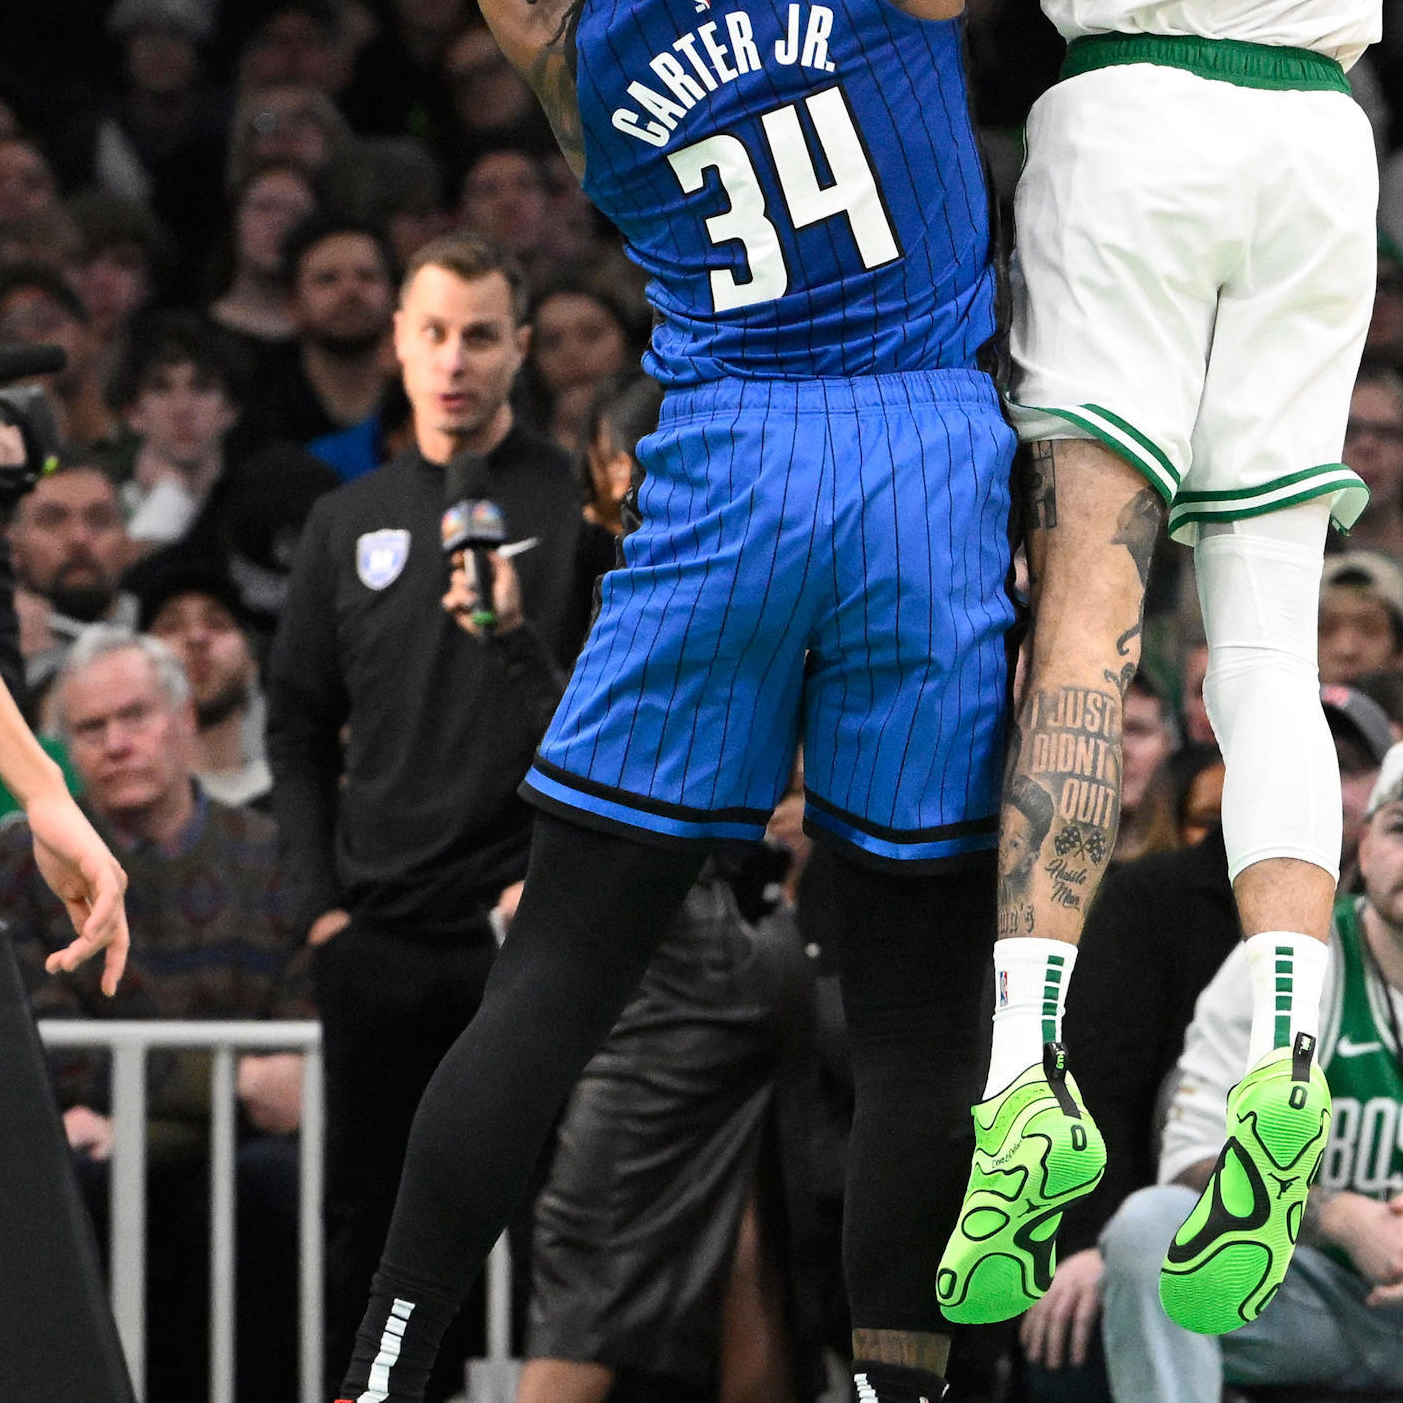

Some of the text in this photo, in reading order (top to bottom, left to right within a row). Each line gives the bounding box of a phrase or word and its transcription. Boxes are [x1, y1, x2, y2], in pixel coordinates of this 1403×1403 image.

[612, 2, 835, 147] CARTER JR.
[667, 86, 902, 312] 34
[1050, 690, 1116, 737] JUST
[1059, 778, 1116, 829] QUIT
